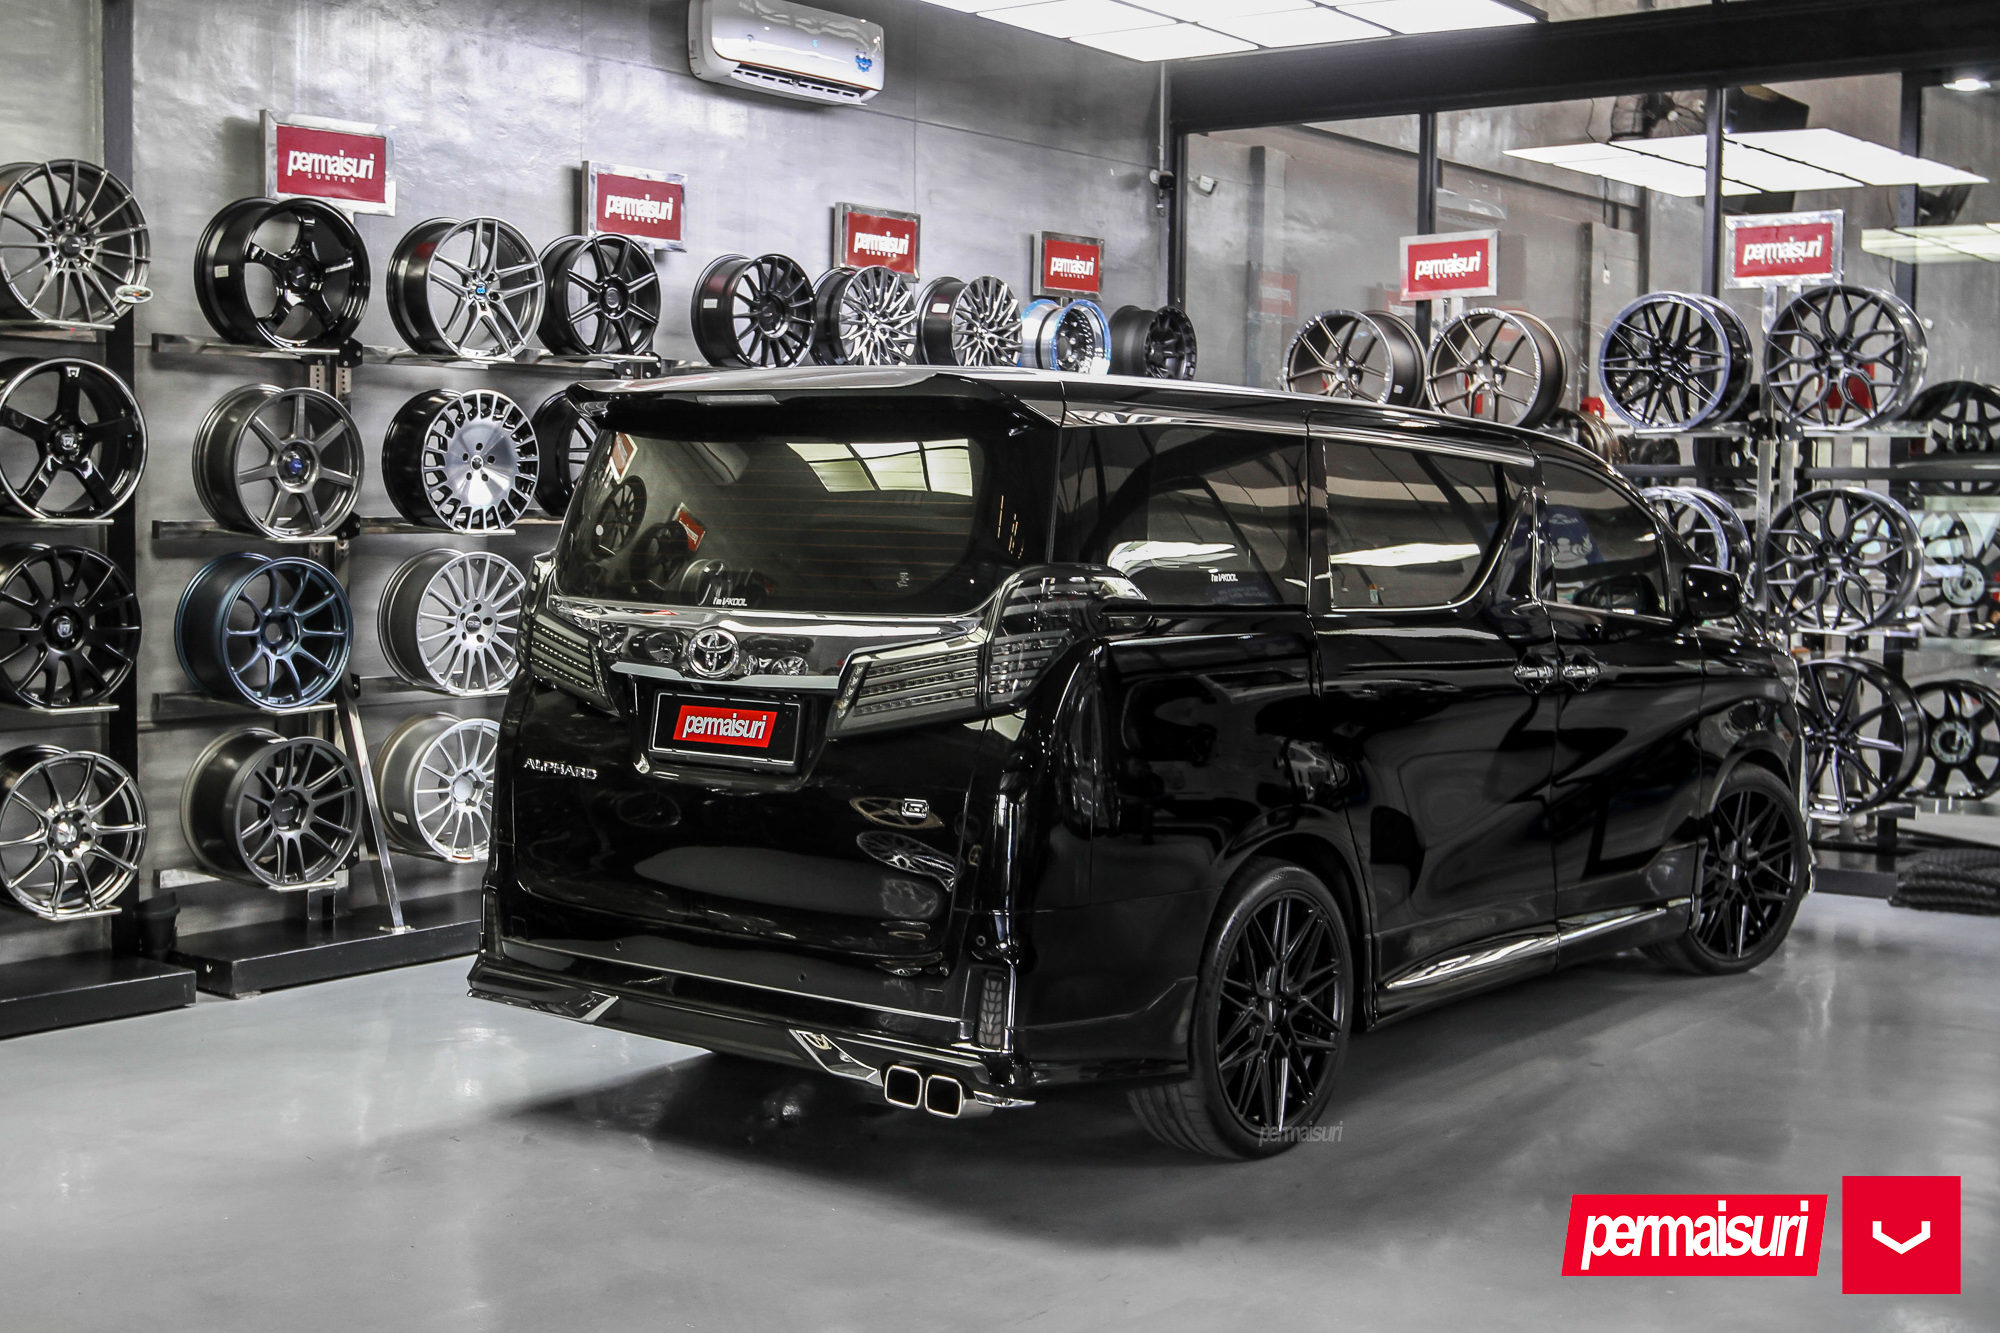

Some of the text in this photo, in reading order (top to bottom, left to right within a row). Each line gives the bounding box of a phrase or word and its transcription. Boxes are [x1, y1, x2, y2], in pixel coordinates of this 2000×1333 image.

[287, 149, 375, 180] permaisuri
[308, 172, 355, 183] SUNTER
[604, 193, 673, 220] permaisuri
[853, 231, 909, 255] permaisuri
[1743, 235, 1823, 266] permaisuri
[1050, 254, 1095, 276] permaisuri
[1414, 251, 1481, 281] permaisuri
[682, 713, 767, 739] permaisuri
[523, 758, 598, 780] ALPHARD
